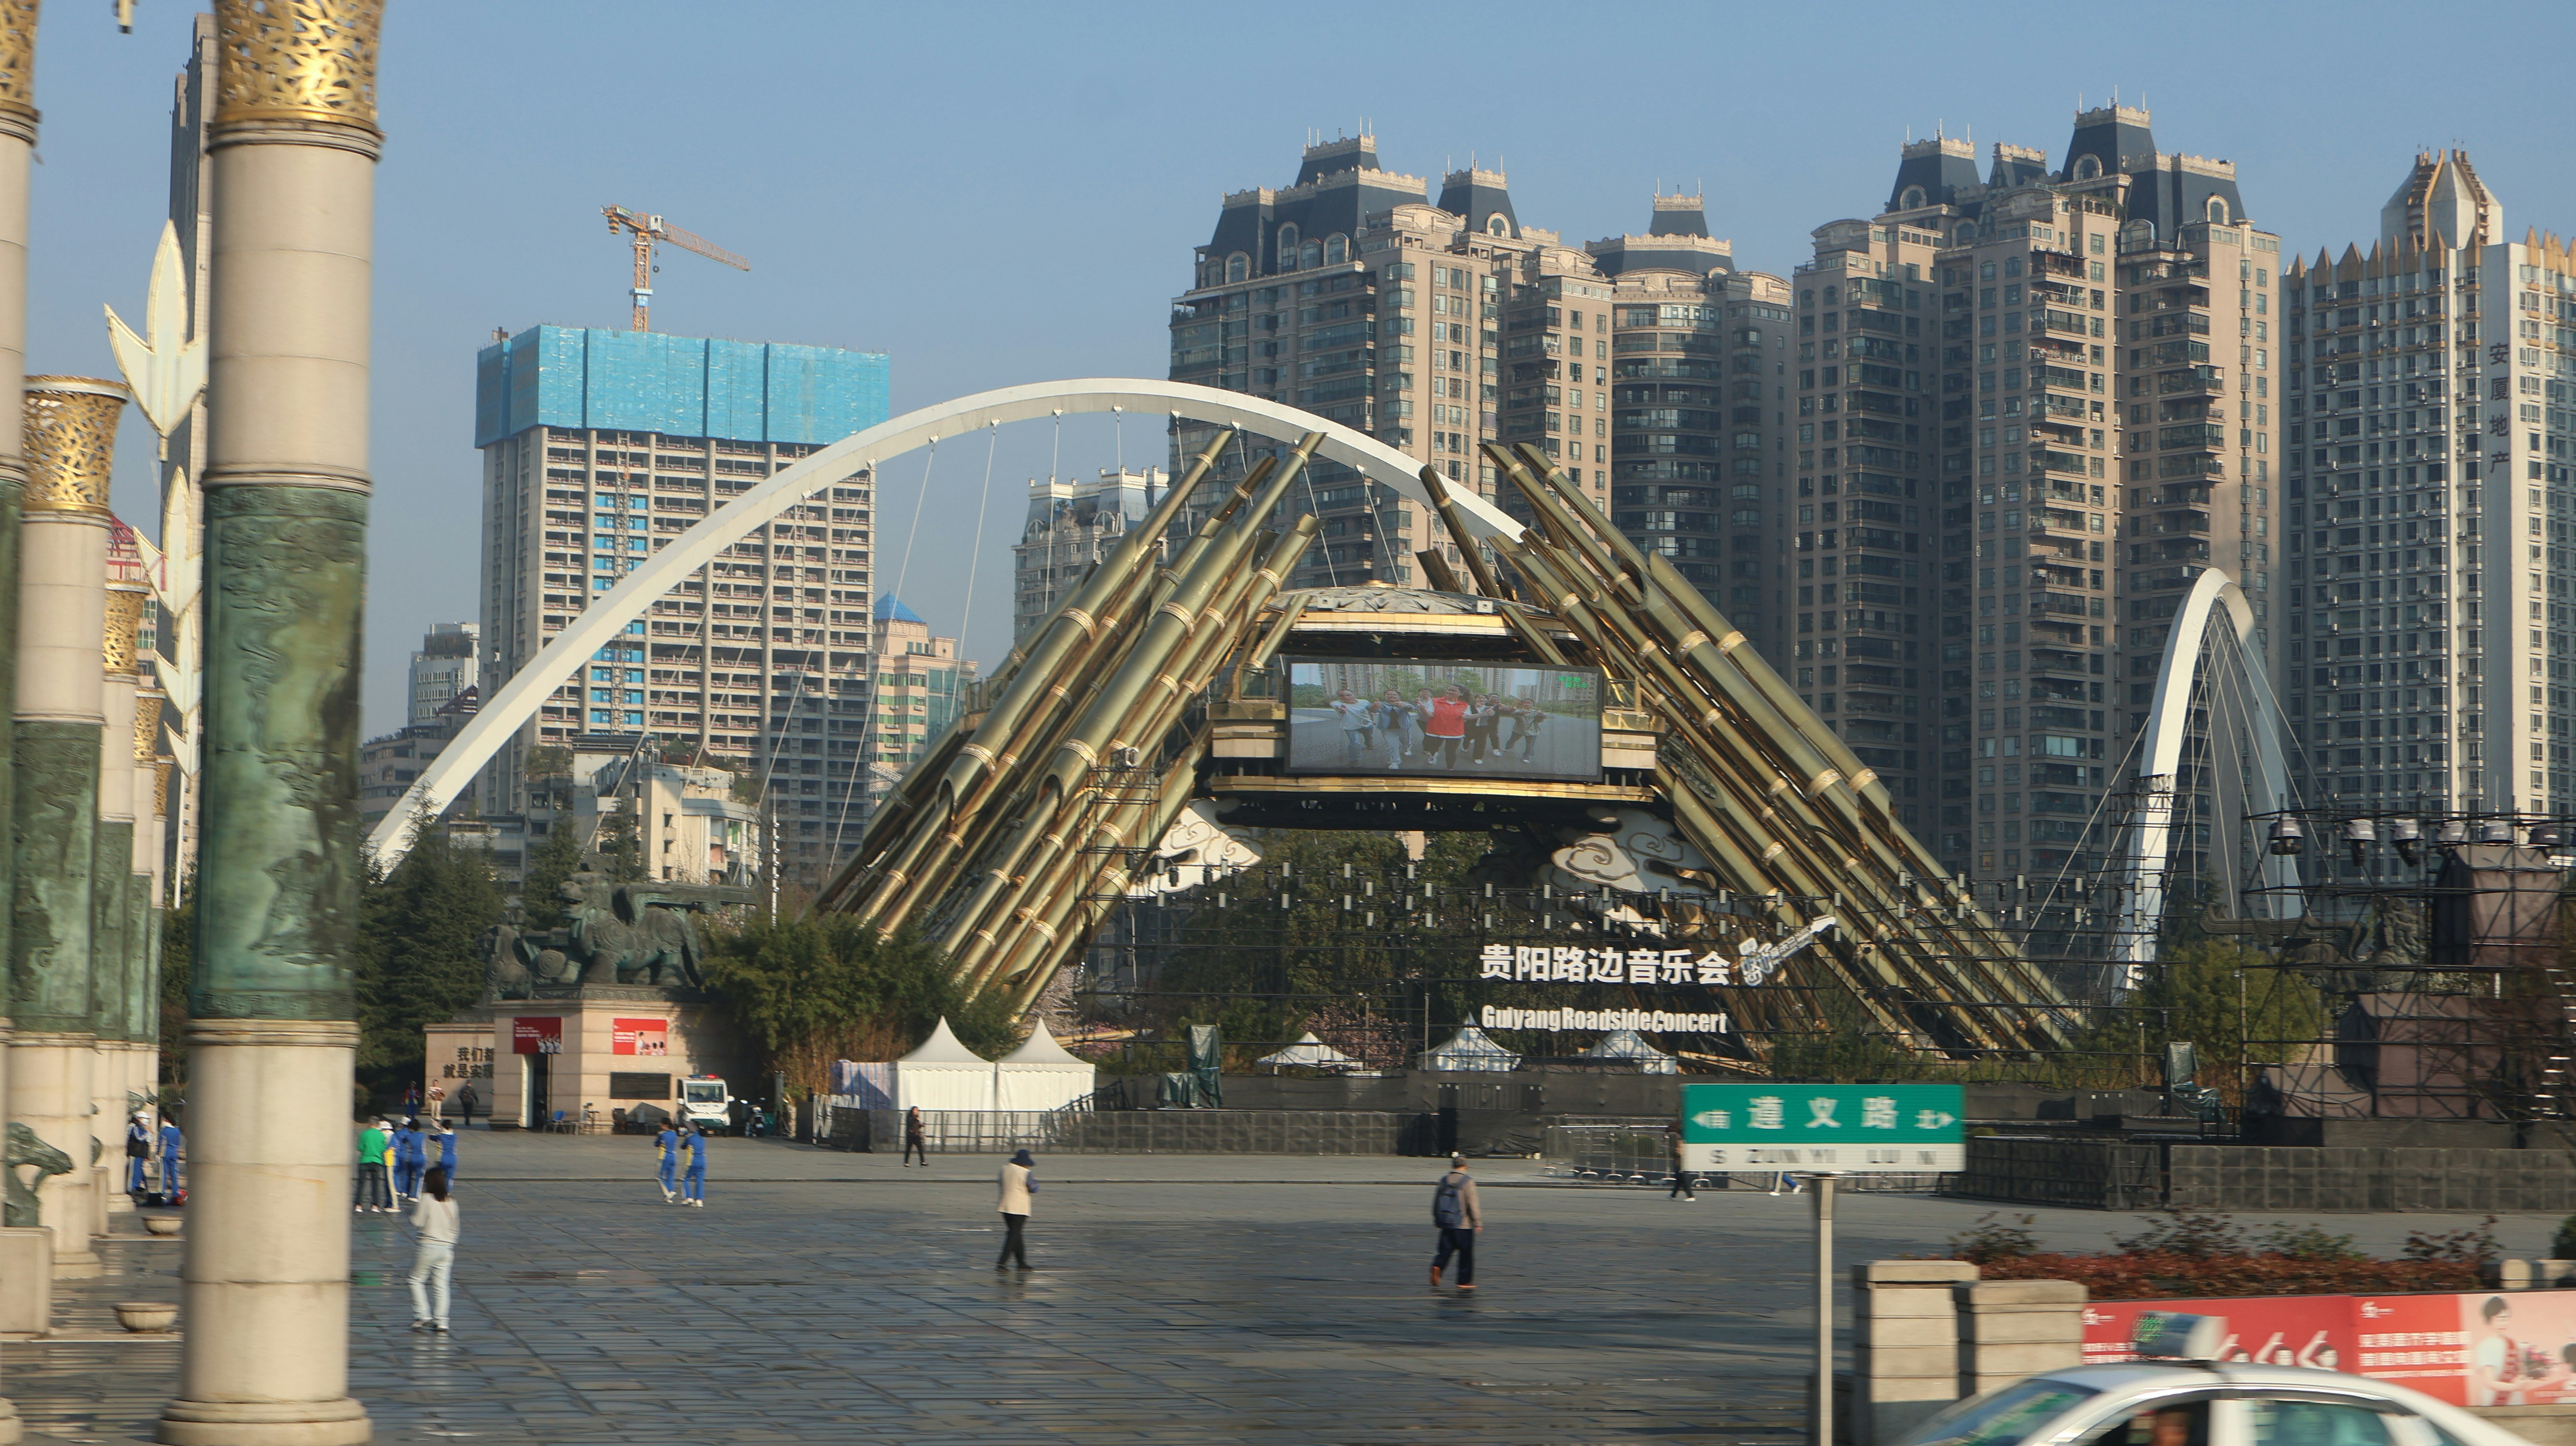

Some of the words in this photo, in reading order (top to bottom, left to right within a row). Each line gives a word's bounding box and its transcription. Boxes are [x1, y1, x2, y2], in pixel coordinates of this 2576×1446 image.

[2489, 343, 2510, 473] 安厦地产
[1479, 944, 1731, 985] 贵阳路边音乐会
[1746, 1096, 1899, 1129] 遵义路
[1914, 1110, 1940, 1129] 北
[1710, 1149, 1727, 1164] S
[1867, 1149, 1901, 1163] LU
